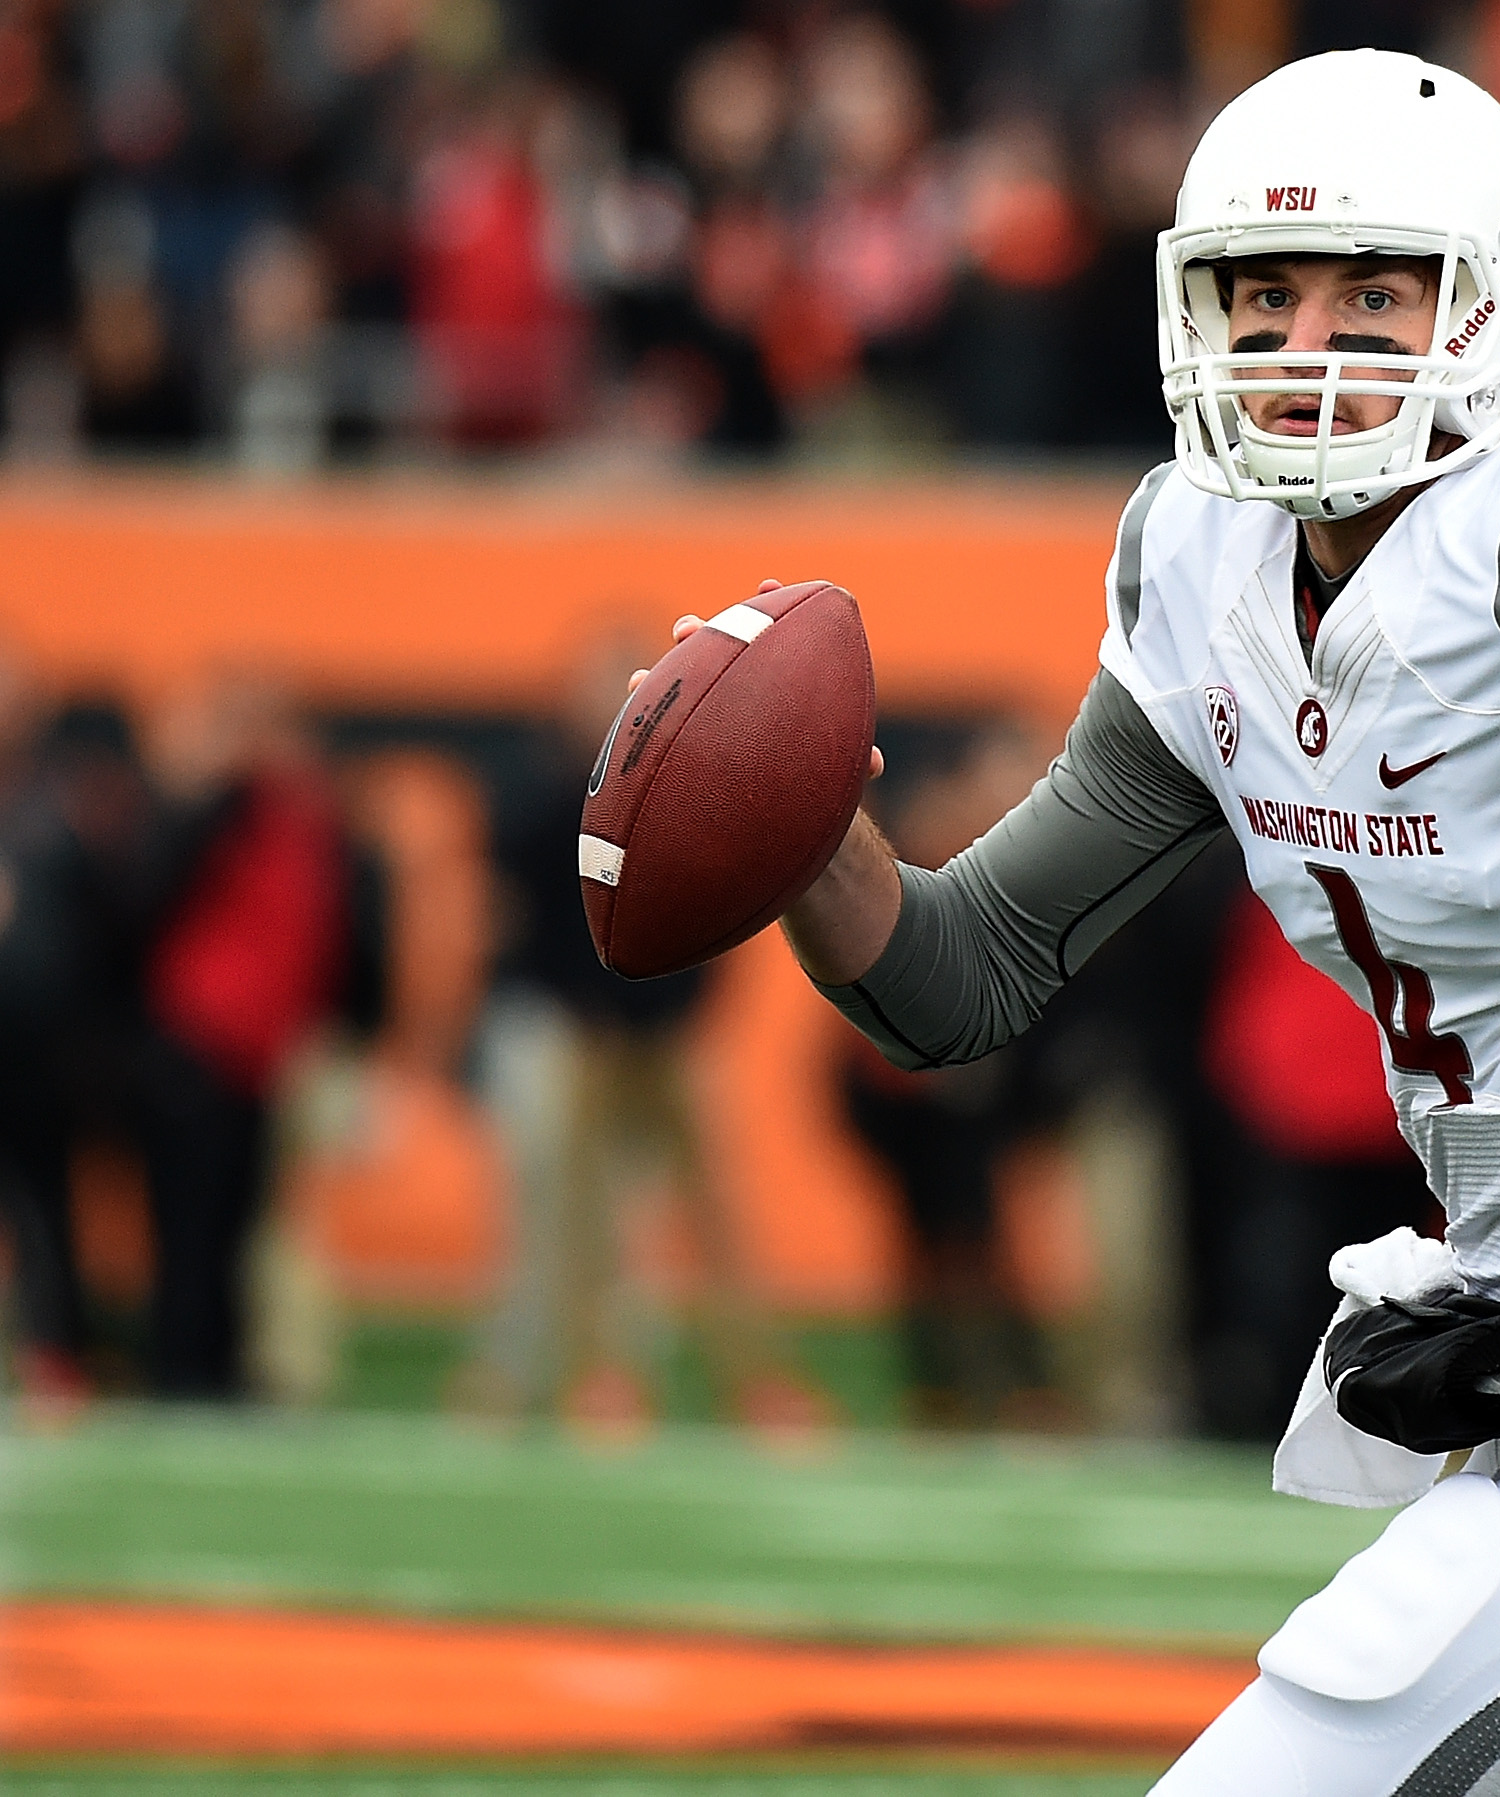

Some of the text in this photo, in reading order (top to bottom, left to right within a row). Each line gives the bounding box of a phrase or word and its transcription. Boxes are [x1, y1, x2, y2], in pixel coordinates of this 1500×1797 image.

[1265, 186, 1317, 212] WSU
[1238, 794, 1445, 858] WASHINGTON STATE
[1303, 861, 1475, 1114] 4
